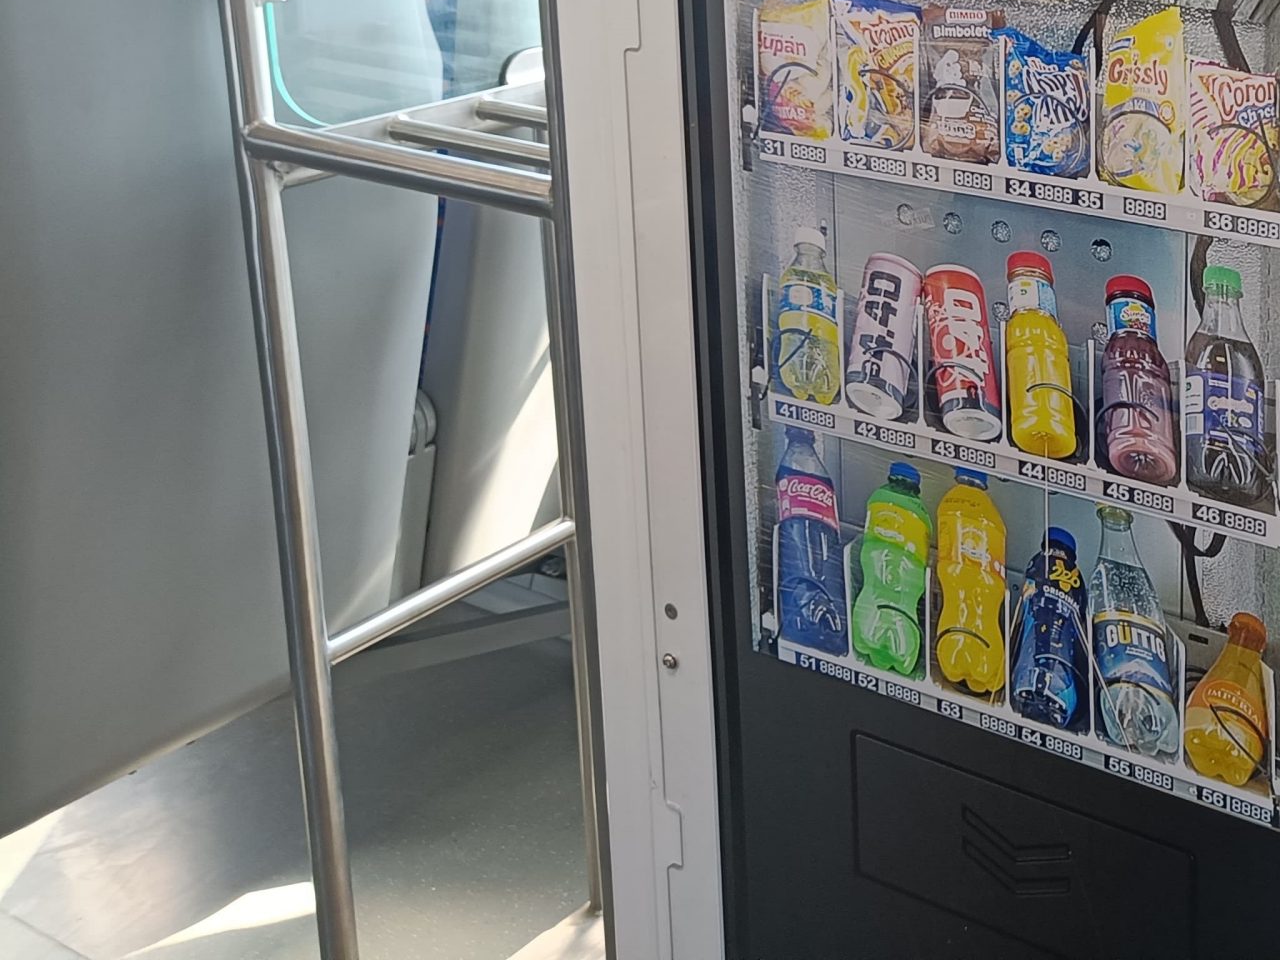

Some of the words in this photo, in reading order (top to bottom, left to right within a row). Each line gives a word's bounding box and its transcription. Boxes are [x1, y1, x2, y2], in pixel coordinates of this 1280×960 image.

[933, 24, 991, 39] Bimbolet
[764, 140, 782, 155] 31
[846, 152, 867, 169] 32
[915, 163, 937, 181] 33
[1008, 180, 1031, 197] 34
[1078, 190, 1100, 208] 35
[1208, 212, 1233, 230] 36
[779, 402, 798, 418] 41
[857, 422, 877, 439] 42
[935, 441, 955, 458] 43
[1022, 463, 1044, 479] 44
[1107, 484, 1129, 501] 45
[1196, 505, 1220, 523] 46
[1106, 622, 1166, 663] GÜITIG
[800, 655, 816, 670] 51
[858, 671, 877, 689] 52
[941, 702, 961, 718] 53
[1022, 728, 1042, 745] 54
[1108, 758, 1130, 775] 55
[1202, 788, 1224, 807] 56
